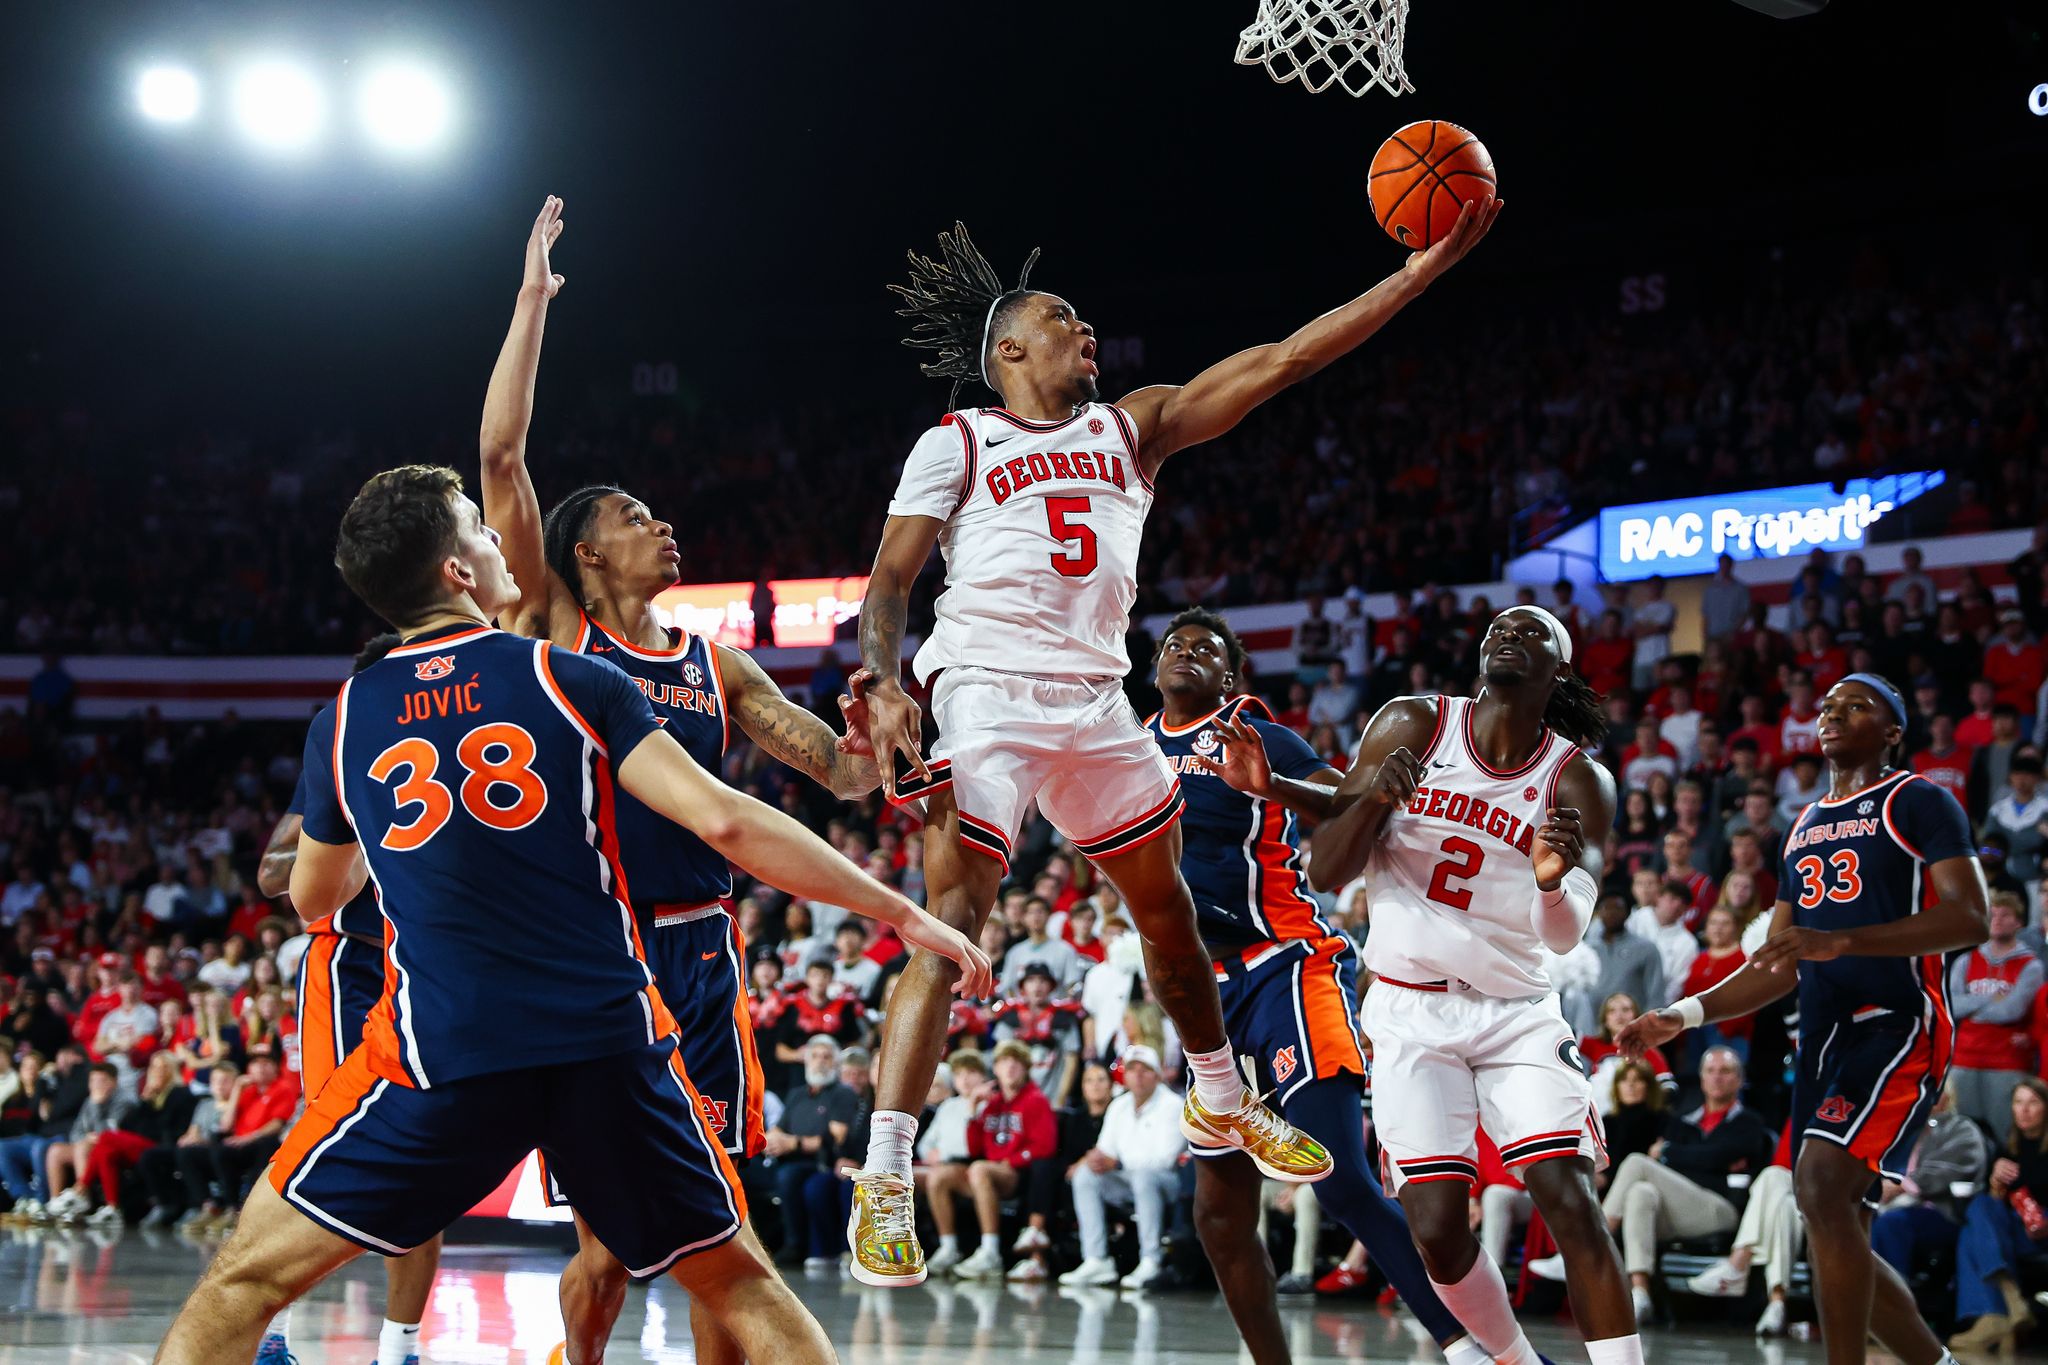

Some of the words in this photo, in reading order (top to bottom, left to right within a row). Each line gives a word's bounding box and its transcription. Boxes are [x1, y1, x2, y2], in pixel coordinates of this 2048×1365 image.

[1620, 273, 1666, 314] SS
[986, 452, 1126, 506] GEORGIA
[1045, 496, 1098, 576] 5
[1620, 512, 1703, 563] RAC
[1712, 494, 1893, 556] Properti
[397, 673, 482, 724] JOVIĆ
[630, 677, 716, 717] BURN
[683, 662, 703, 686] SEC
[367, 722, 547, 852] 38
[1408, 787, 1534, 857] GEORGIA
[1426, 835, 1485, 911] 2
[1795, 848, 1863, 909] 33
